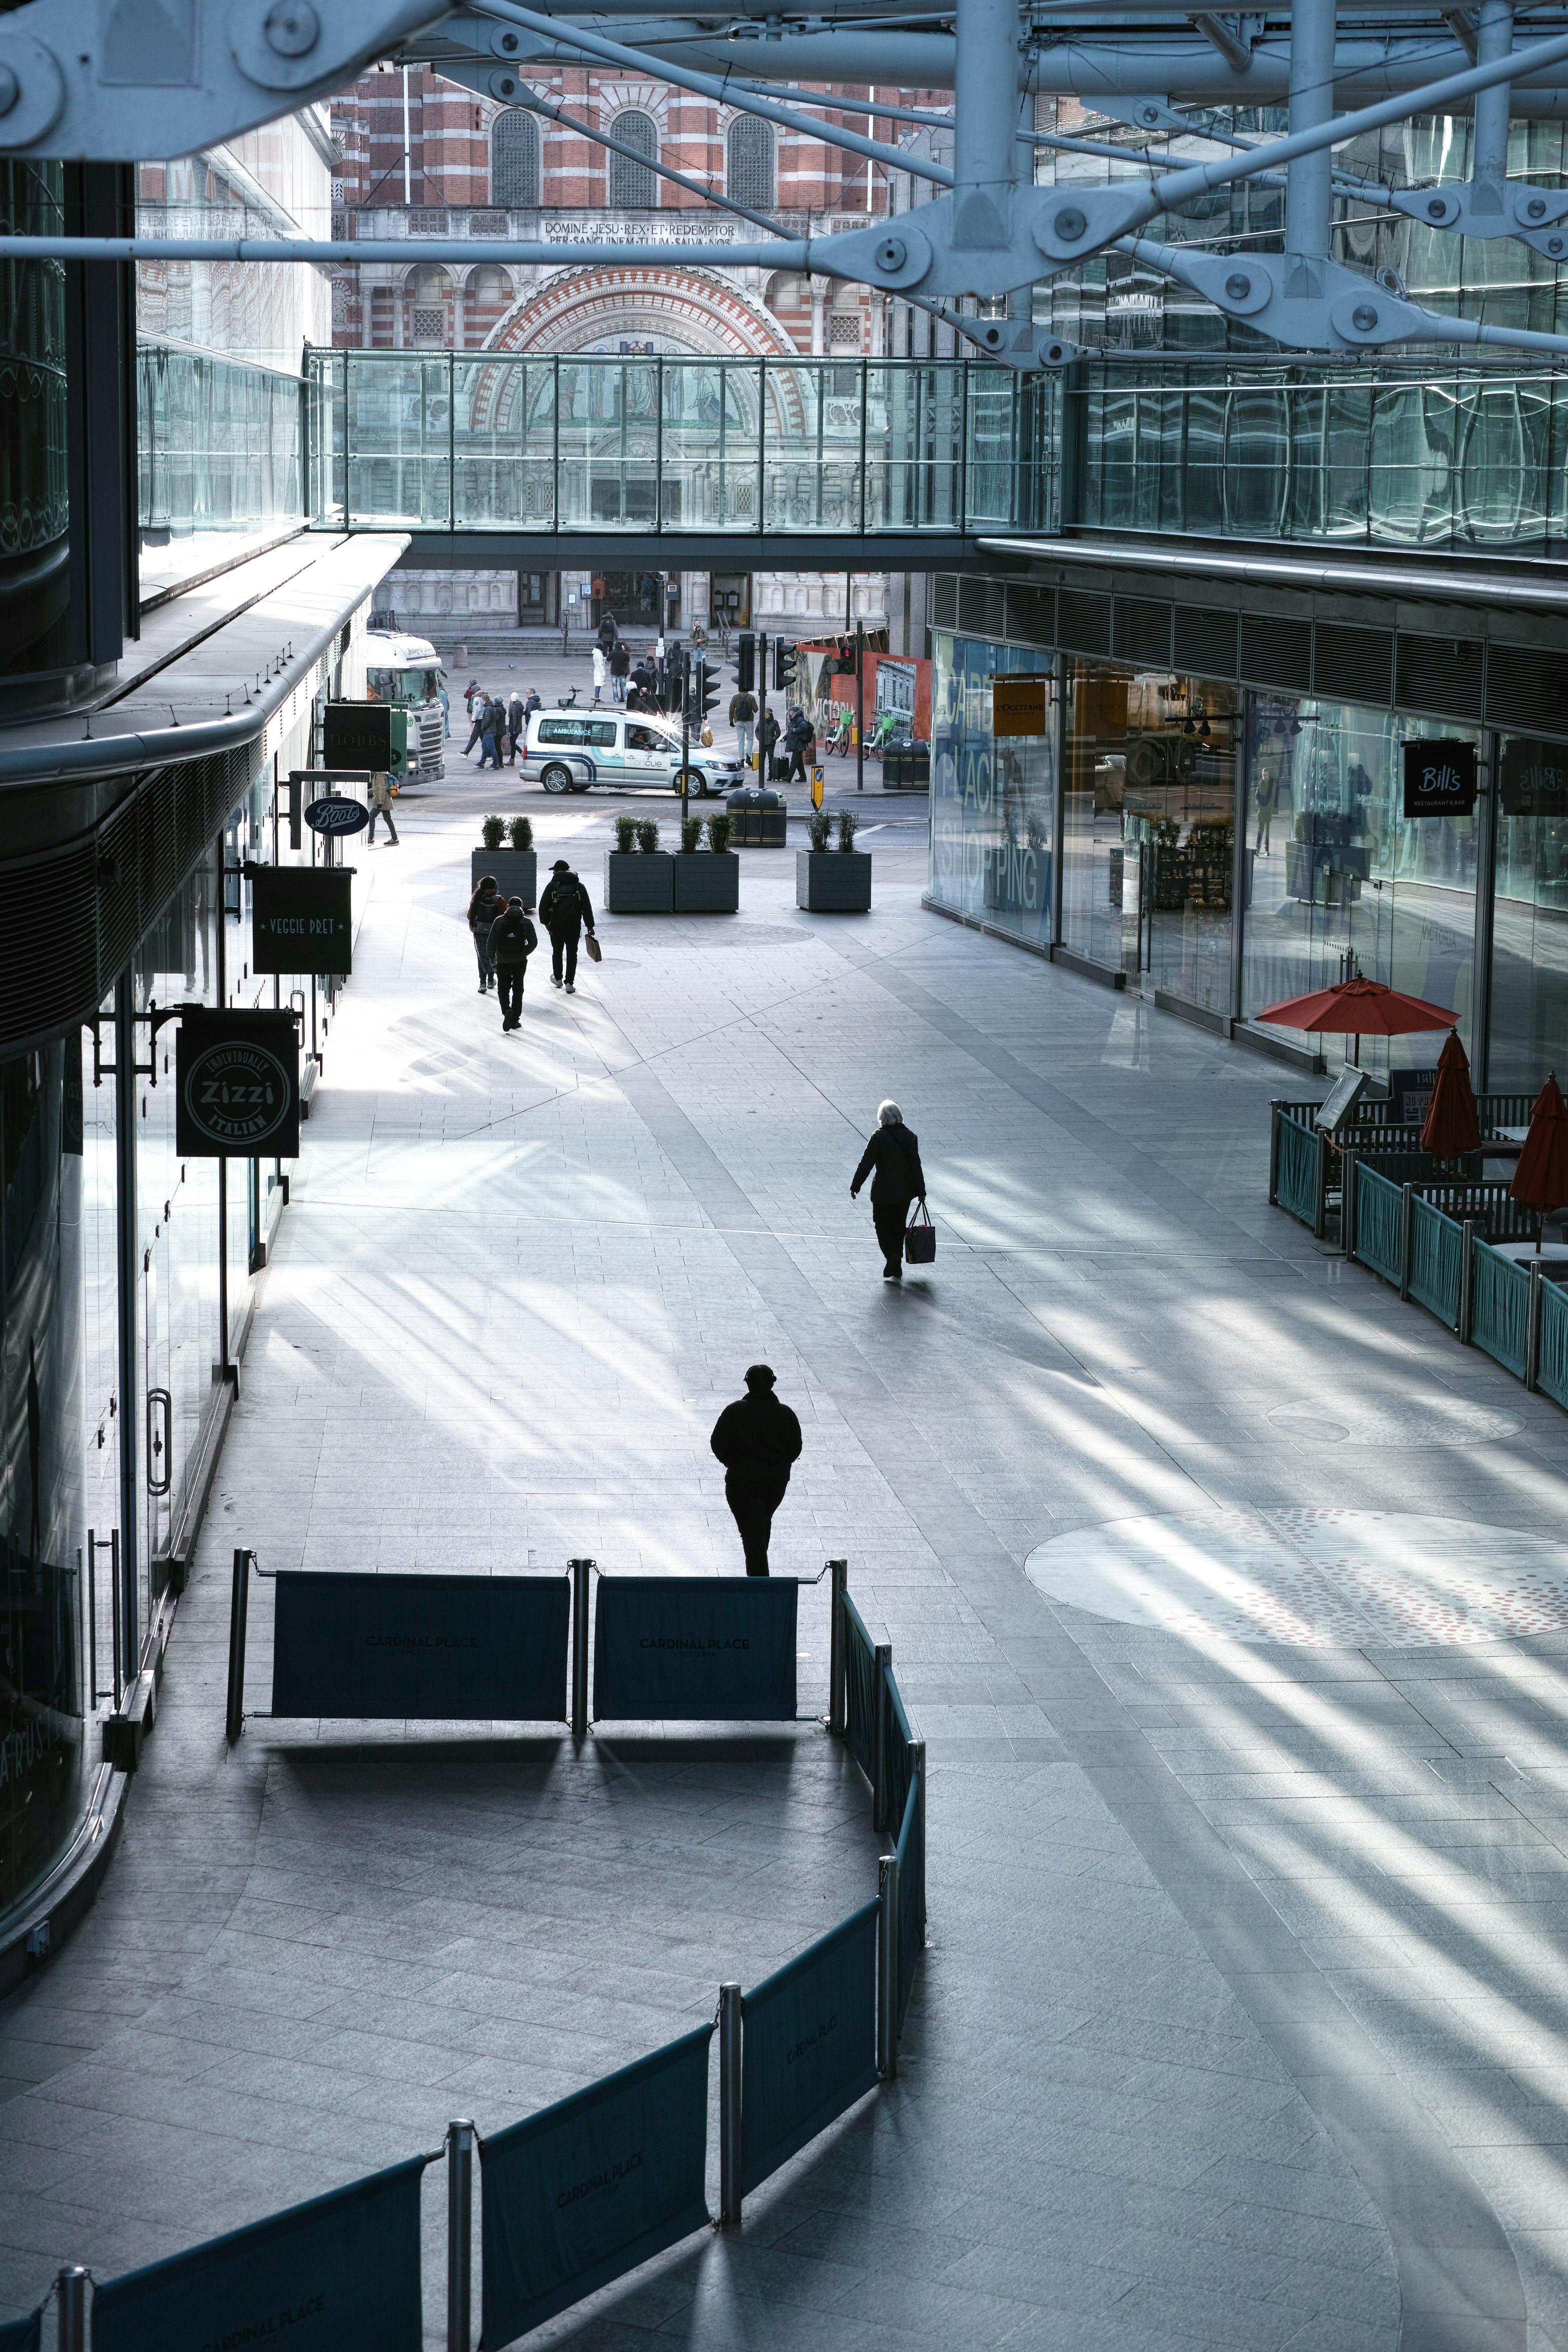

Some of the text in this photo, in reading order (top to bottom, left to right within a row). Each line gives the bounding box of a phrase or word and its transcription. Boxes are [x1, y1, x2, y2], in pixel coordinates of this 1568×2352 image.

[545, 222, 735, 236] DOMINE JESU REX ET REDEMPTOR
[330, 734, 386, 746] HOBBS
[634, 760, 662, 768] oncue
[1418, 764, 1460, 792] Bill's
[310, 804, 360, 828] Boots
[942, 818, 1036, 910] SHOPPING
[270, 918, 334, 934] VEGGIE PRET
[1422, 924, 1456, 949] VICTORIA
[204, 1050, 270, 1072] INDIVIDUALLY
[200, 1081, 274, 1104] Zizzi
[208, 1114, 268, 1135] ITALIAN
[366, 1636, 478, 1648] CARDINAL PLACE
[640, 1638, 750, 1650] CARDINAL PLACE
[558, 2170, 611, 2208] CARDINAL
[612, 2149, 644, 2180] PLACE
[280, 2293, 324, 2328] PLACE
